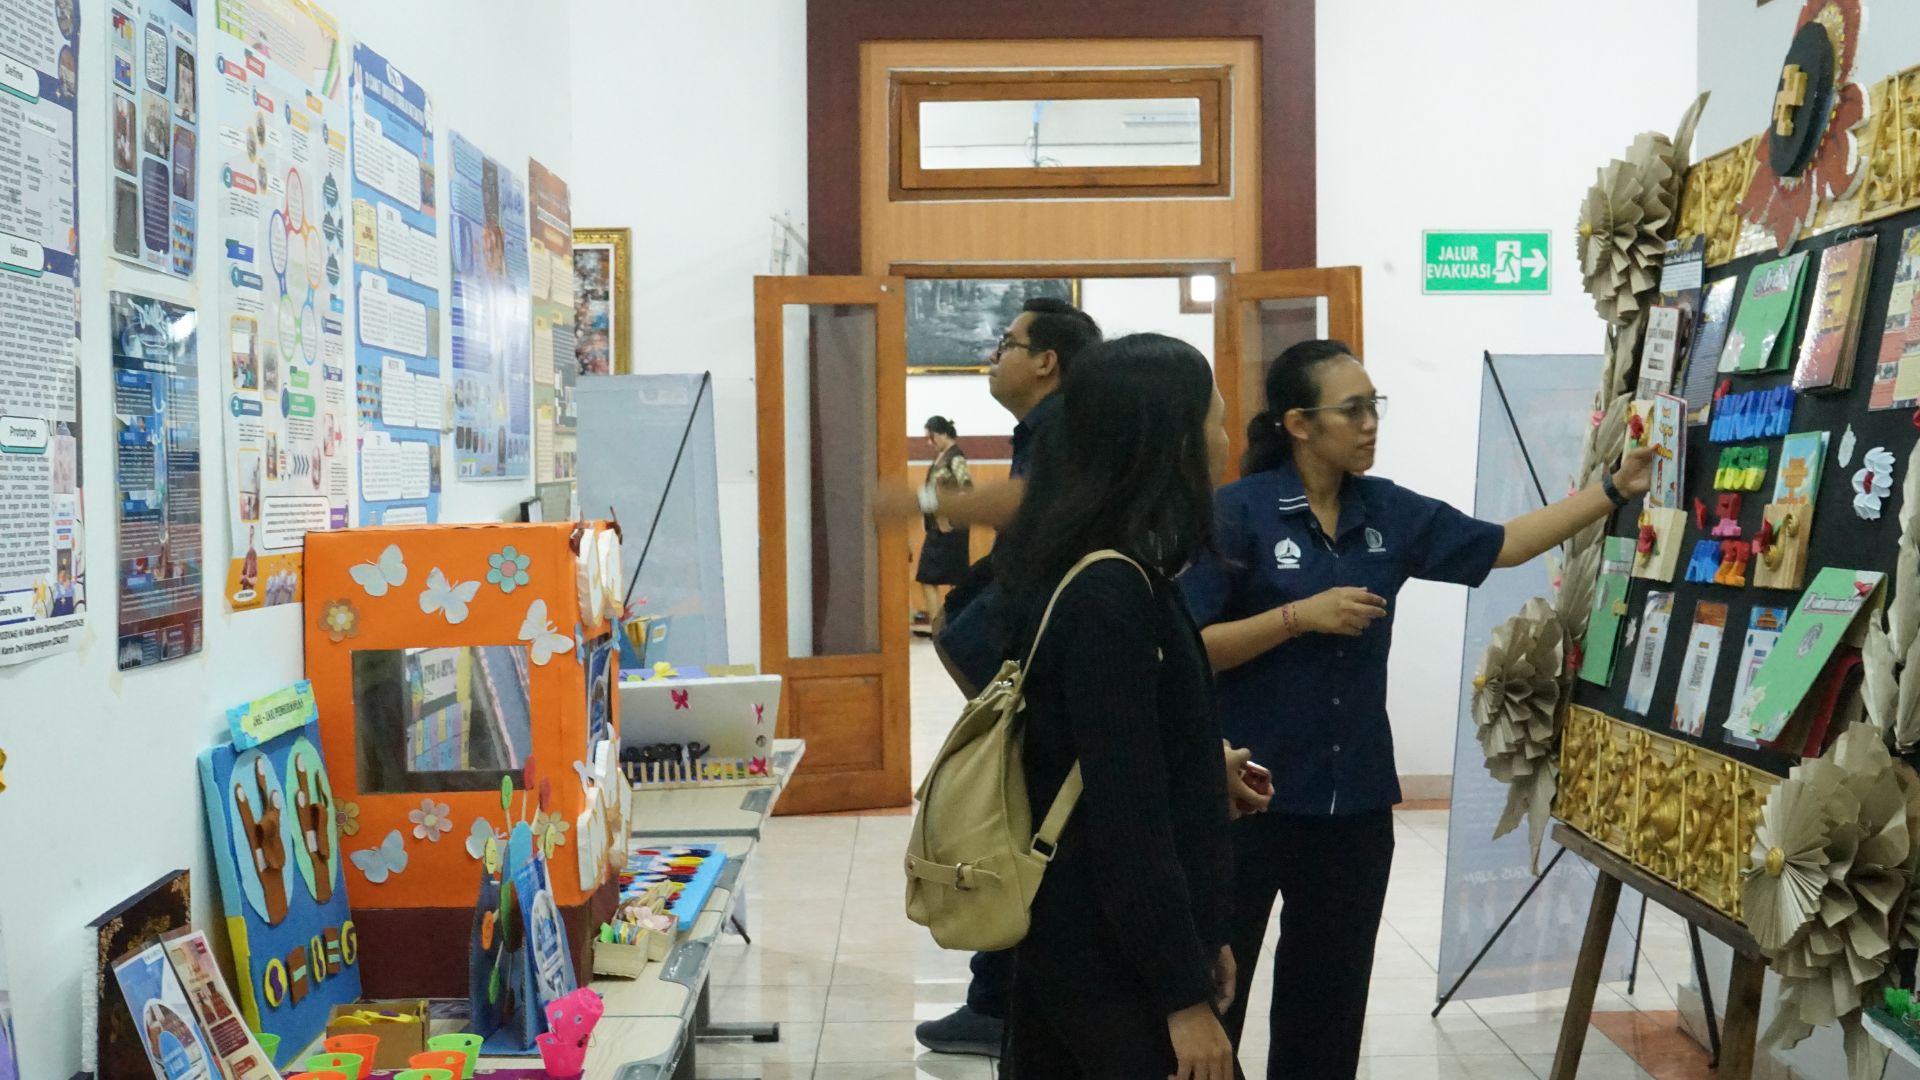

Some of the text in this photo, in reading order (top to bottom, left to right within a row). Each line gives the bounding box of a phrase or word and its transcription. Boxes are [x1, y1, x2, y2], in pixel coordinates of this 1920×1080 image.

[5, 63, 23, 80] Define
[10, 243, 28, 258] Ideate
[1438, 246, 1479, 261] JALUR
[1427, 263, 1491, 279] EVAKUASI
